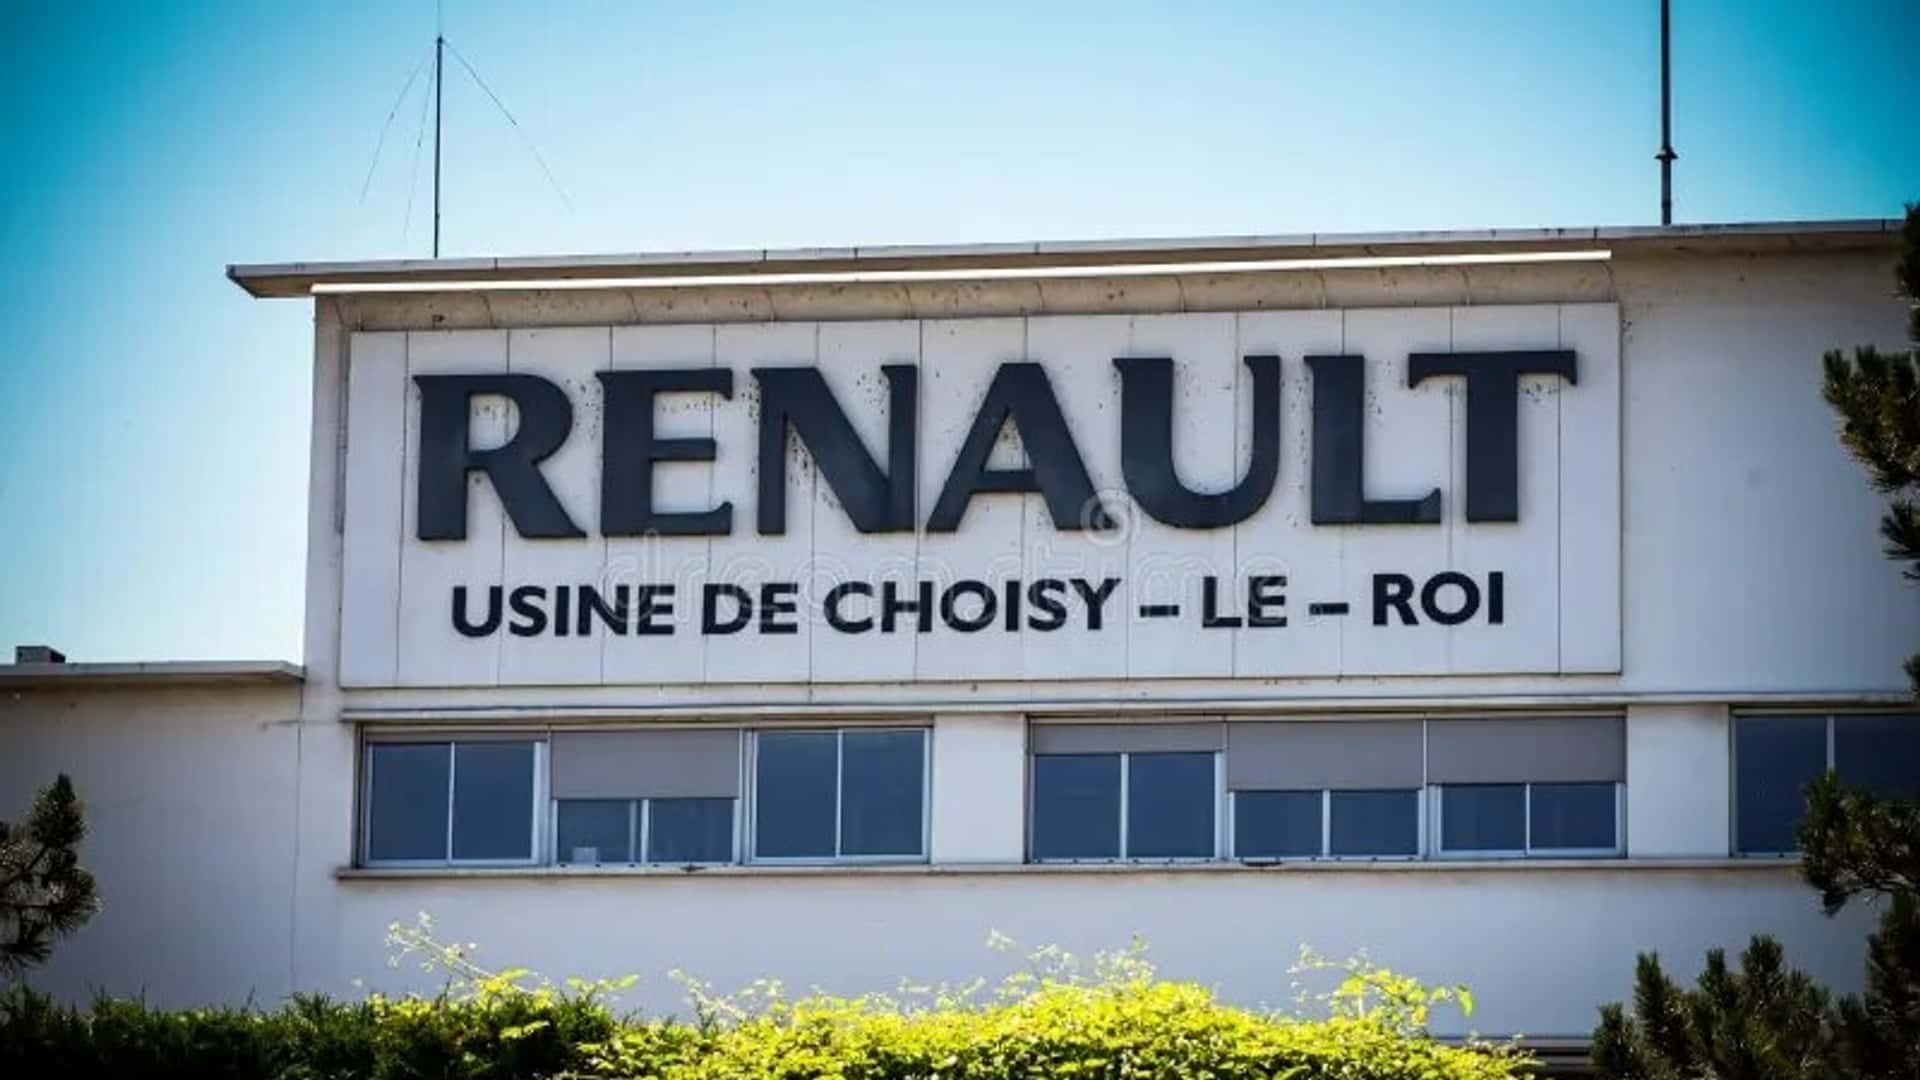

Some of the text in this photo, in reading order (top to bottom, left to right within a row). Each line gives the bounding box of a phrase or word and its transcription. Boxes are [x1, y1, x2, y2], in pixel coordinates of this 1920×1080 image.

[413, 349, 1578, 541] RENAULT
[452, 585, 675, 638] USINE
[701, 583, 798, 635] DE
[824, 577, 1121, 634] CHOISY
[1202, 576, 1288, 629] LE
[1373, 571, 1504, 627] ROI
